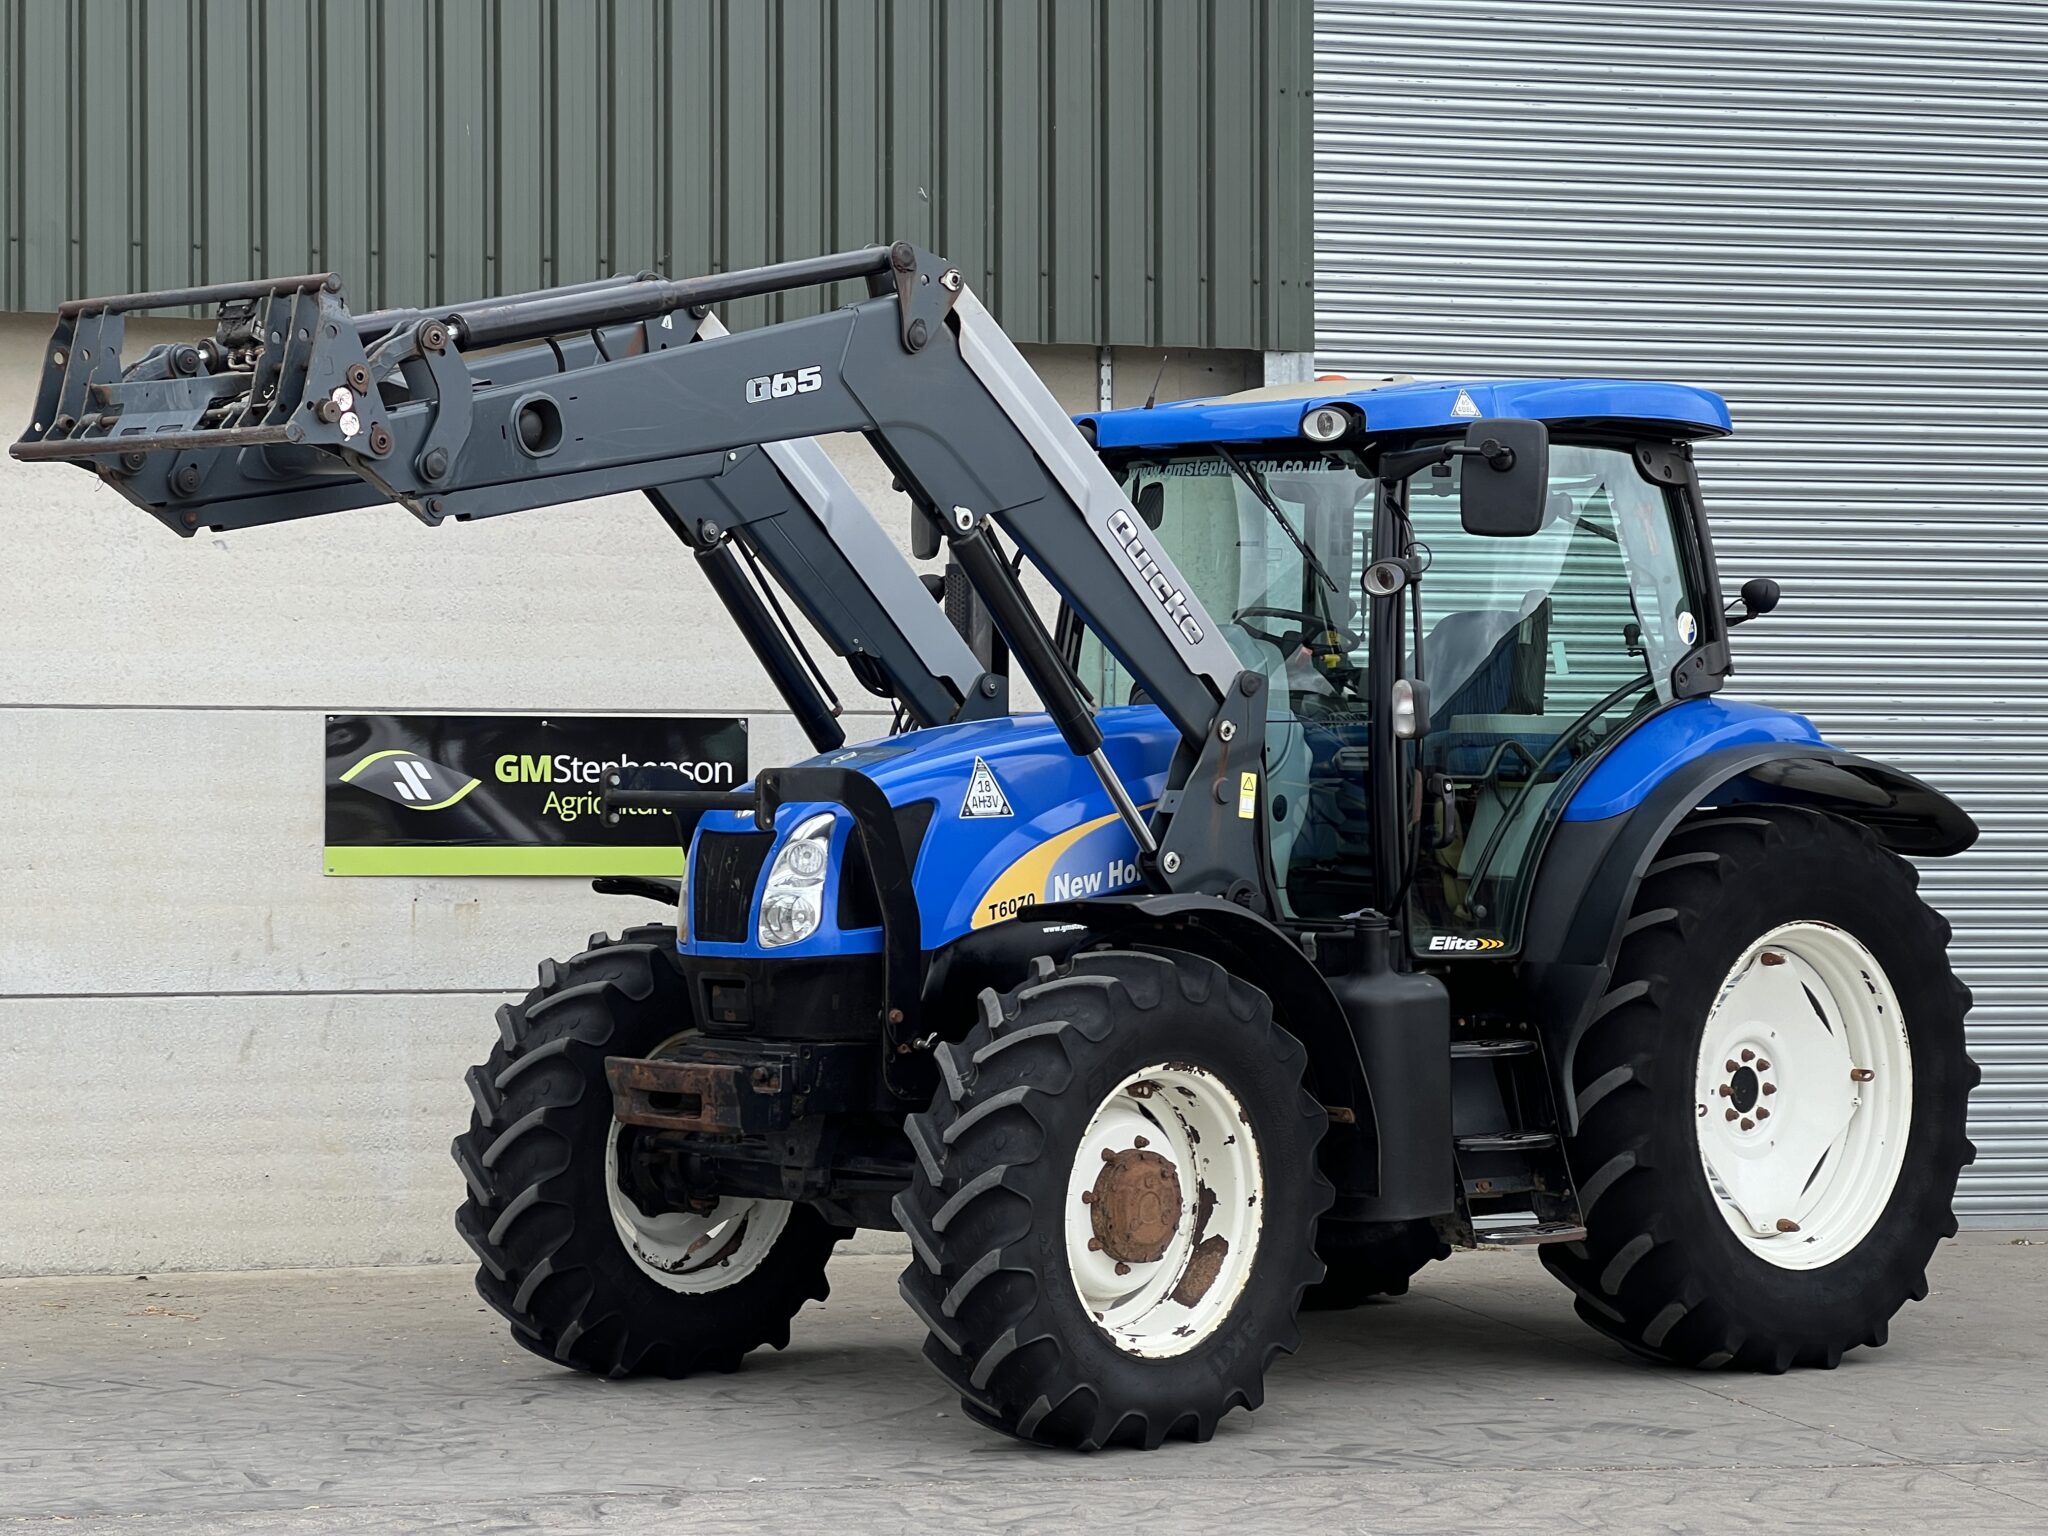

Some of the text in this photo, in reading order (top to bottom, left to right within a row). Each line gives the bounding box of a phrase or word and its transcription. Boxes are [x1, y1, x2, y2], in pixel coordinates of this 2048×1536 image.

[1107, 509, 1204, 645] Quicke
[977, 780, 992, 793] 18
[972, 795, 999, 809] AH3V
[1054, 871, 1103, 902] New
[988, 892, 1036, 920] T6070
[1428, 936, 1479, 951] Elite
